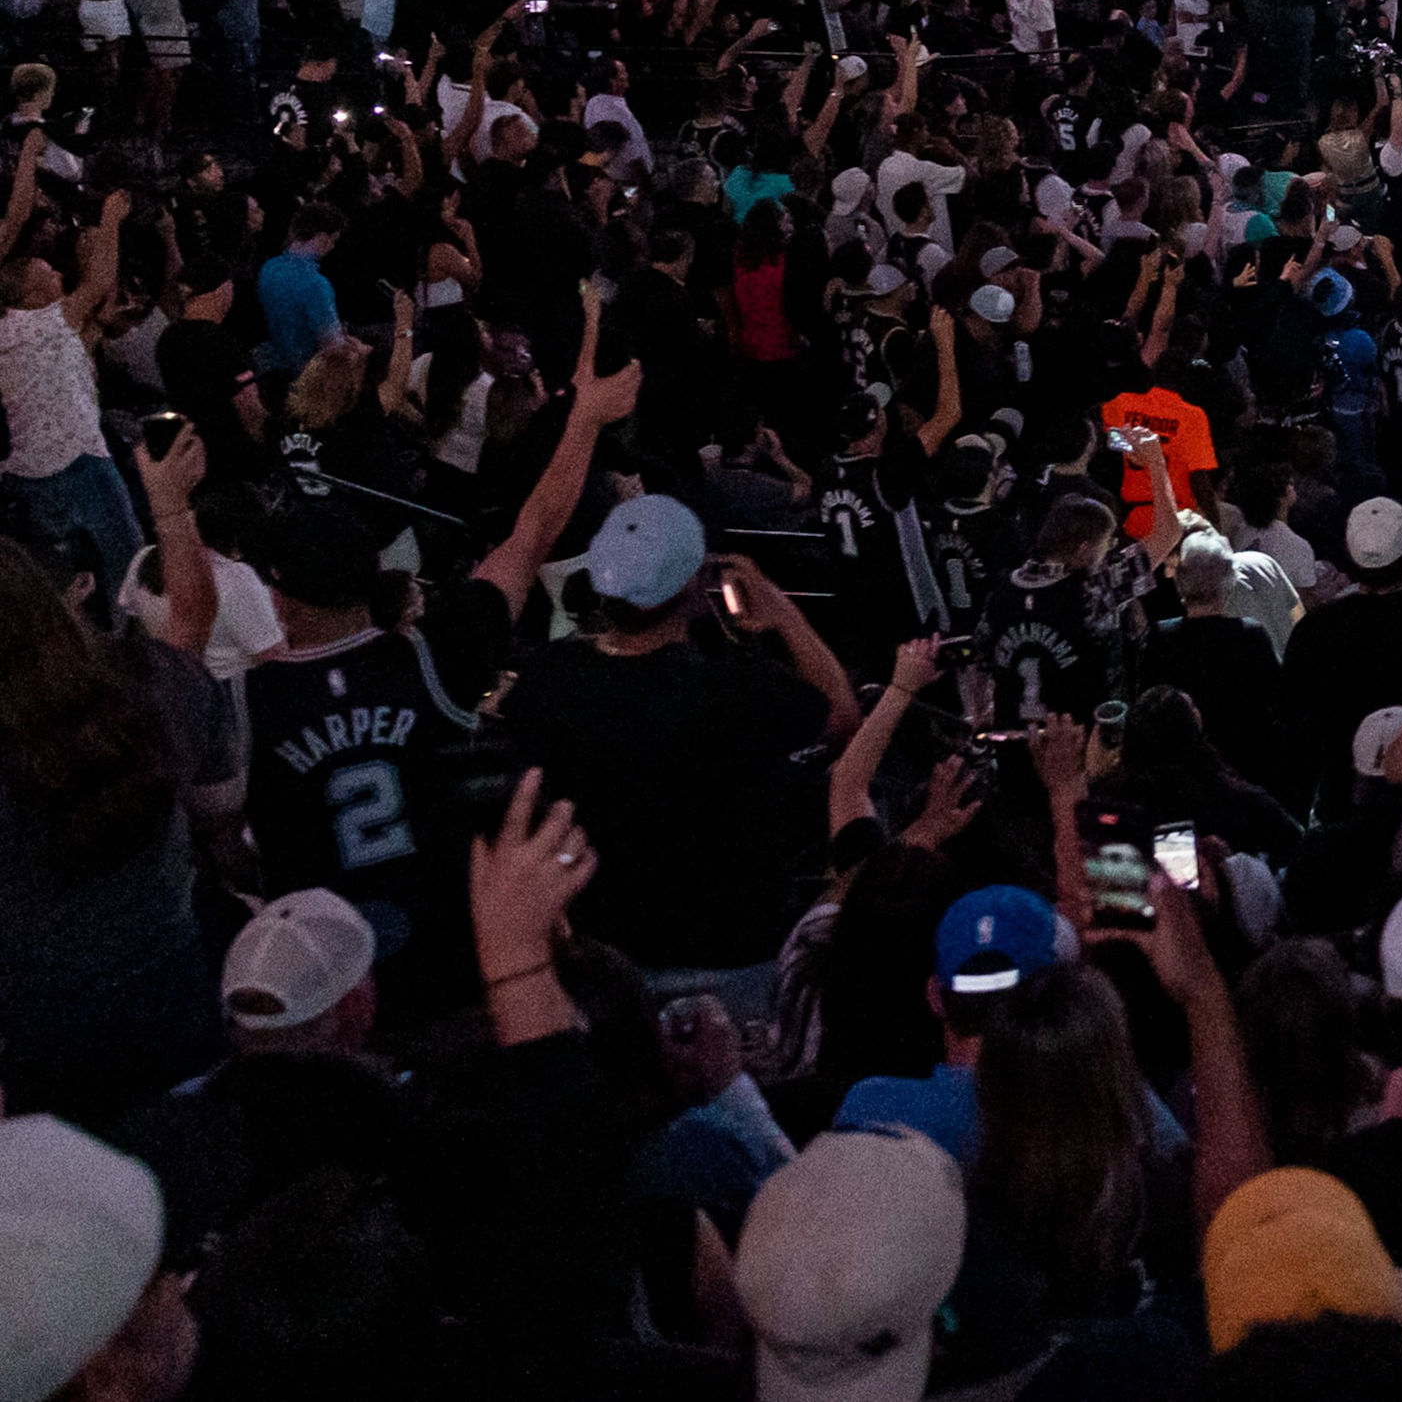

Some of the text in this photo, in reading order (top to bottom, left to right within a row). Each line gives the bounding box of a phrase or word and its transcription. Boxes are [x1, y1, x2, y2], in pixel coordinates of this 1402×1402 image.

[834, 509, 859, 557] 1
[945, 557, 973, 609] 1
[1017, 657, 1048, 721] 1
[274, 705, 417, 774] HARPER
[324, 759, 418, 870] 2
